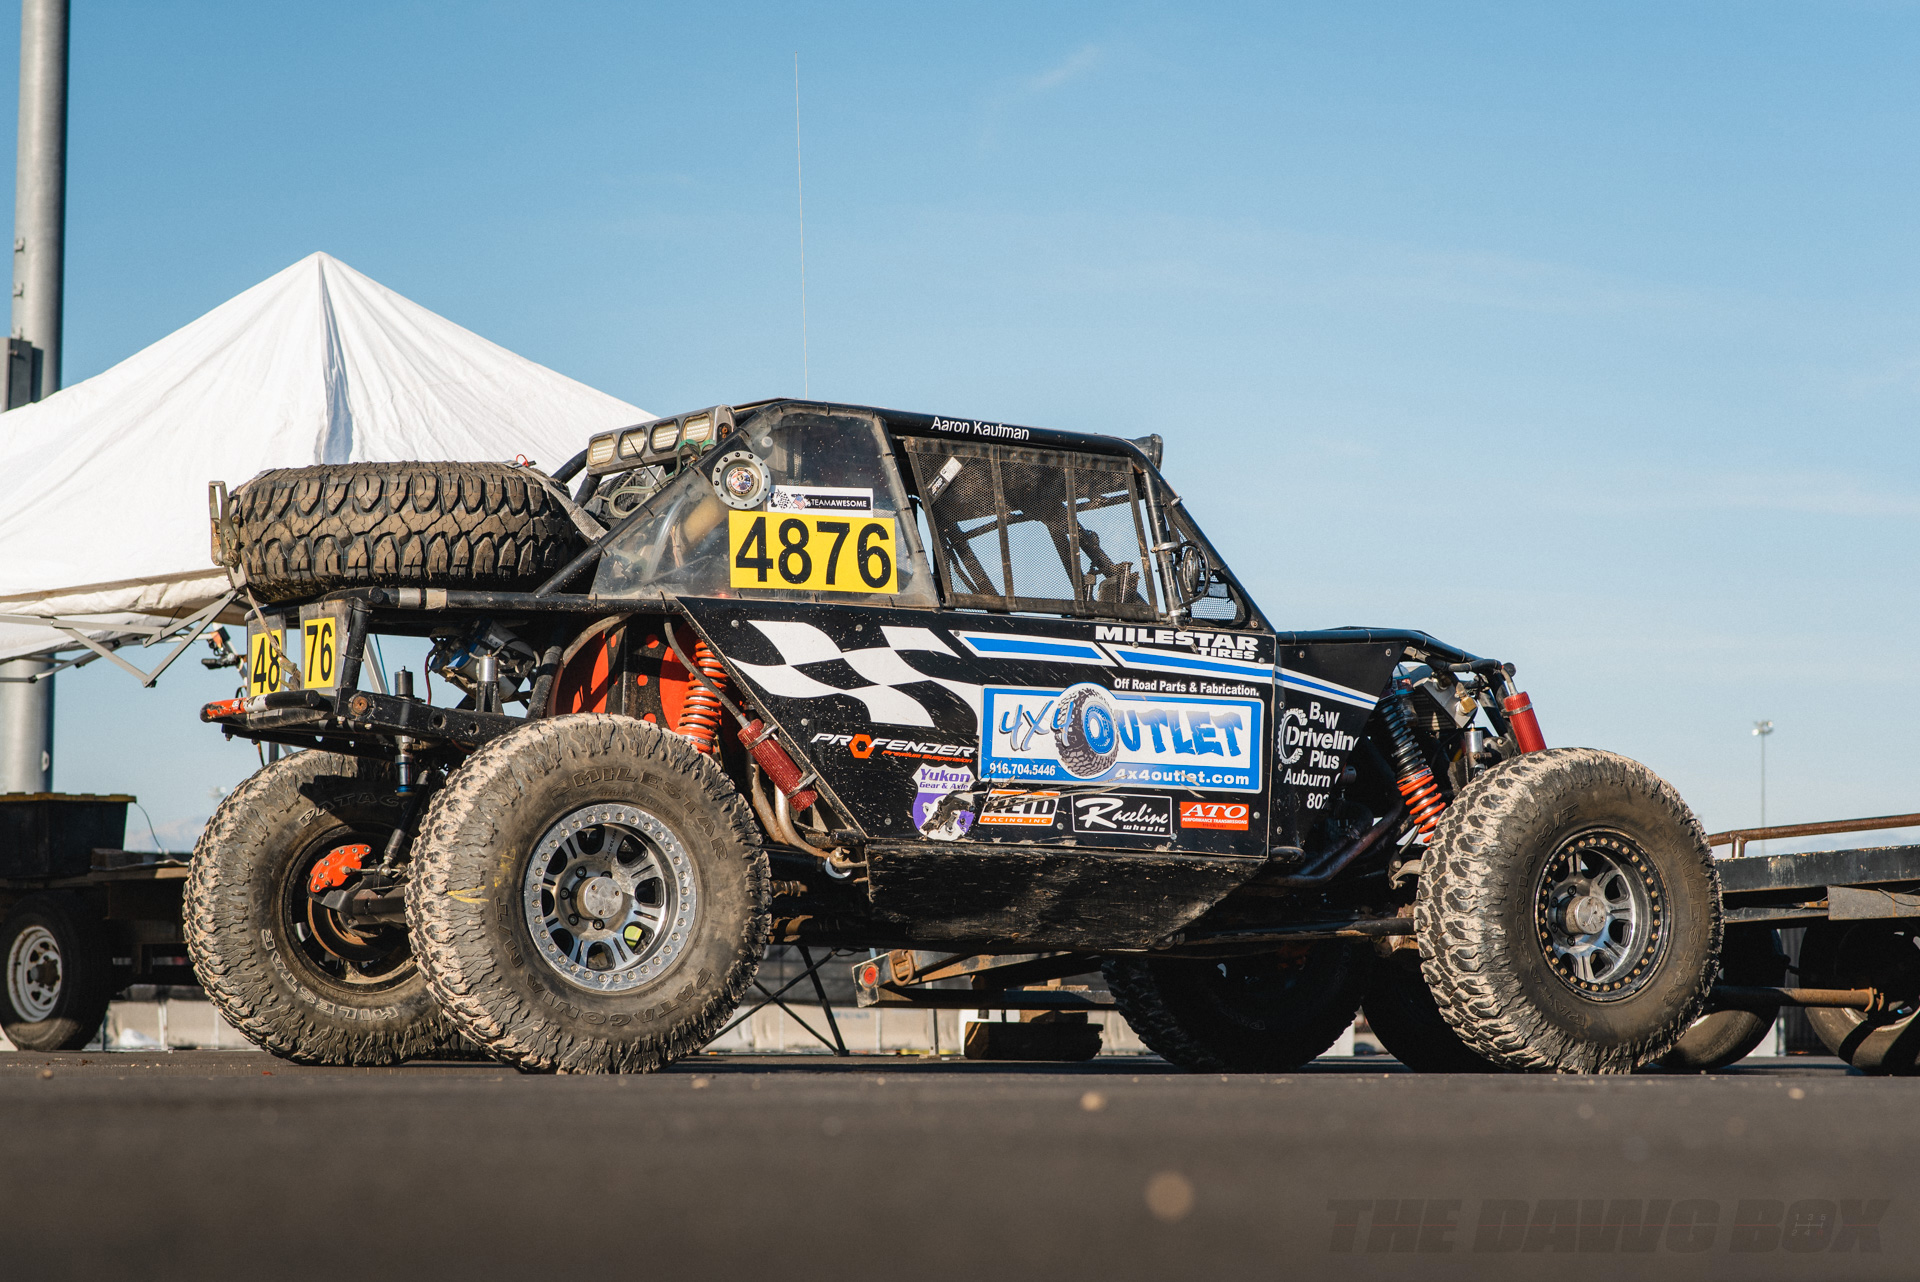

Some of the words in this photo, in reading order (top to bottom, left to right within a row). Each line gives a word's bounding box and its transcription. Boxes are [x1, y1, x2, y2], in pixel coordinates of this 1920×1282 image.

[931, 416, 970, 434] Aaron
[973, 420, 1030, 440] Kaufman
[735, 516, 892, 589] 4876
[1095, 625, 1259, 652] MILESTAR
[306, 622, 333, 682] 76
[1197, 646, 1256, 660] TIRES
[252, 635, 280, 694] 48
[1114, 678, 1130, 689] Off
[1132, 678, 1157, 691] Road
[1159, 680, 1187, 692] Parts
[1189, 682, 1198, 693] &
[1200, 682, 1260, 697] Fabrication.
[989, 762, 1056, 776] 916.704.5446
[1309, 749, 1340, 770] Plus
[919, 781, 940, 789] Gear
[920, 768, 971, 783] Yukon
[1114, 768, 1250, 785] 4x4outlet.com
[1283, 768, 1331, 788] Auburn
[1075, 797, 1169, 829] Raceline
[1182, 804, 1247, 819] ATO
[1122, 823, 1166, 833] wheels
